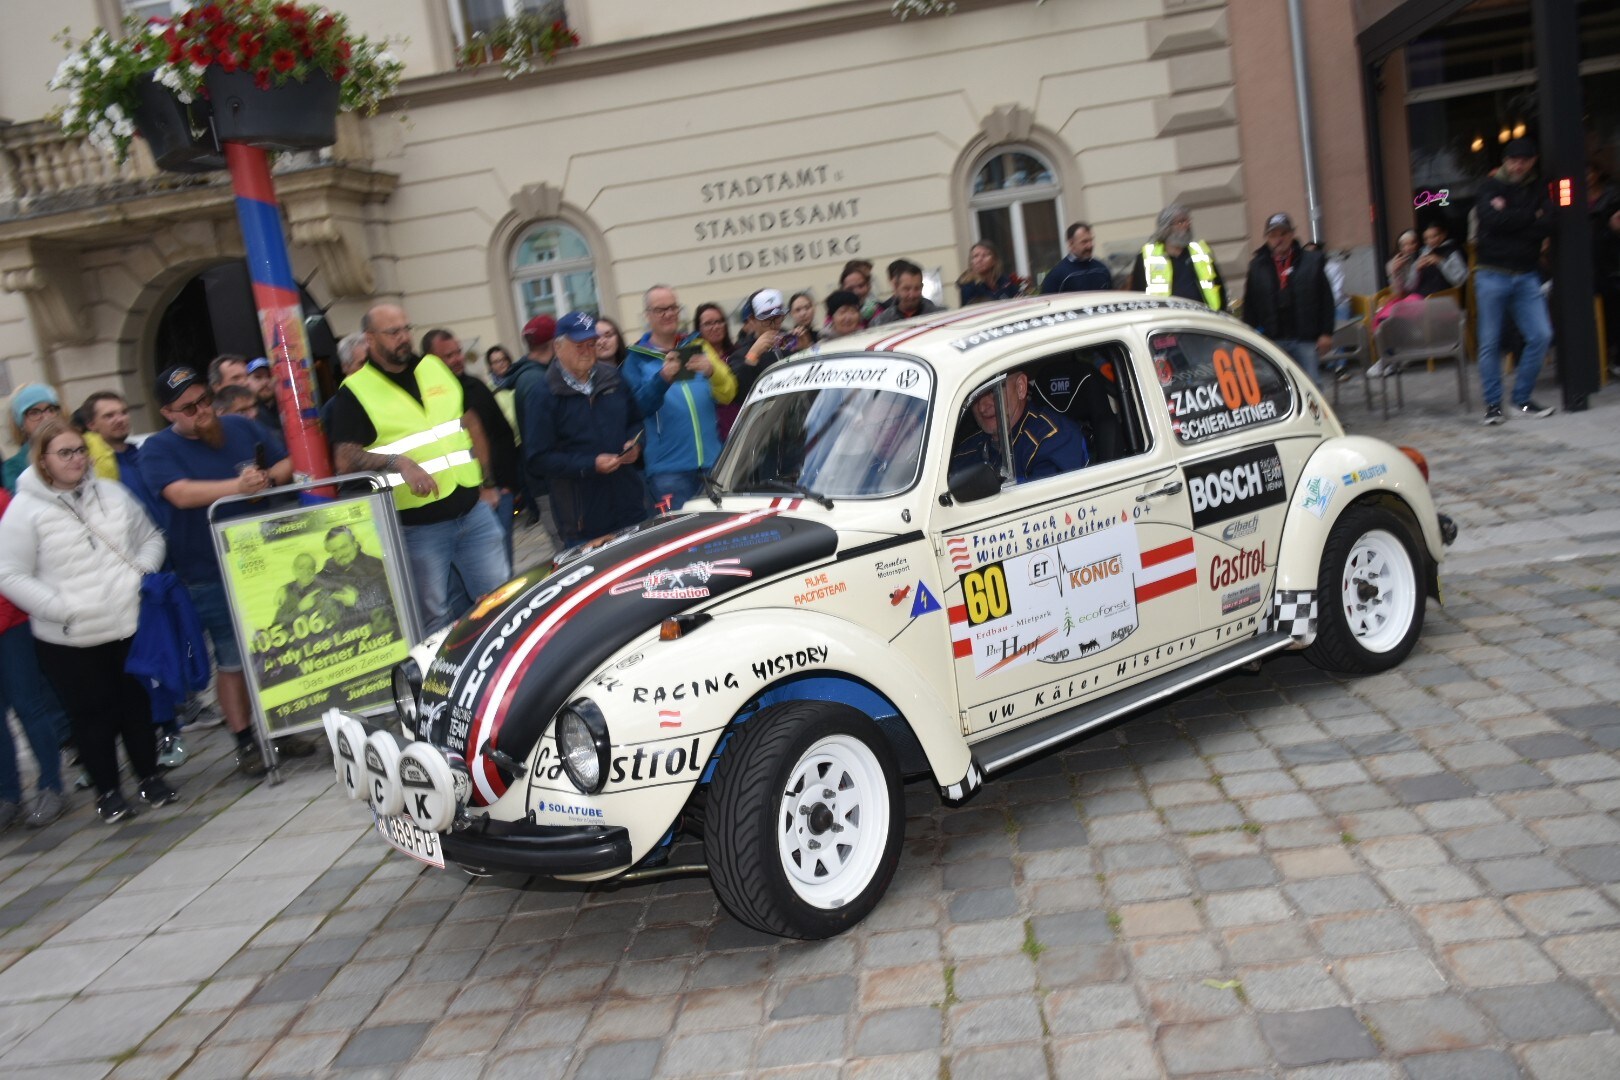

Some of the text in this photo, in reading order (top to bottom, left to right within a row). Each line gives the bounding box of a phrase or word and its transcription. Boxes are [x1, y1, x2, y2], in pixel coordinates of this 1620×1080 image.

[701, 164, 829, 203] STADTAMT
[694, 197, 862, 242] STANDESAMT
[706, 234, 863, 276] JUDENBURG
[1050, 380, 1070, 392] OMP
[1213, 345, 1262, 411] 60
[1170, 383, 1224, 417] ZACK
[1179, 400, 1277, 441] SCHIERLEITNER
[1189, 460, 1263, 513] BOSCH
[973, 529, 1016, 549] Franz
[1022, 515, 1057, 536] Zack
[976, 543, 1019, 564] Willi
[1026, 514, 1117, 550] Schierleitner
[1222, 516, 1259, 541] Eibach
[877, 565, 910, 579] Motorsport
[1033, 560, 1049, 578] ET
[1068, 556, 1121, 590] KÖNIG
[1210, 540, 1266, 592] Castrol
[963, 565, 1009, 625] 60
[1078, 600, 1131, 624] ecoforst
[303, 638, 333, 658] Lee
[333, 622, 372, 647] Lang
[458, 564, 596, 709] BOSCH
[976, 625, 1008, 640] Erdbau
[1016, 611, 1052, 628] Mietpark
[299, 630, 395, 676] Werner Auer
[326, 664, 359, 681] waren
[988, 615, 1257, 725] VW Käfer History Team
[633, 673, 740, 704] RACING
[752, 645, 829, 683] HISTORY
[309, 690, 331, 706] Uhr
[374, 778, 385, 804] C
[414, 792, 433, 820] K
[548, 803, 604, 818] SOLATUBE
